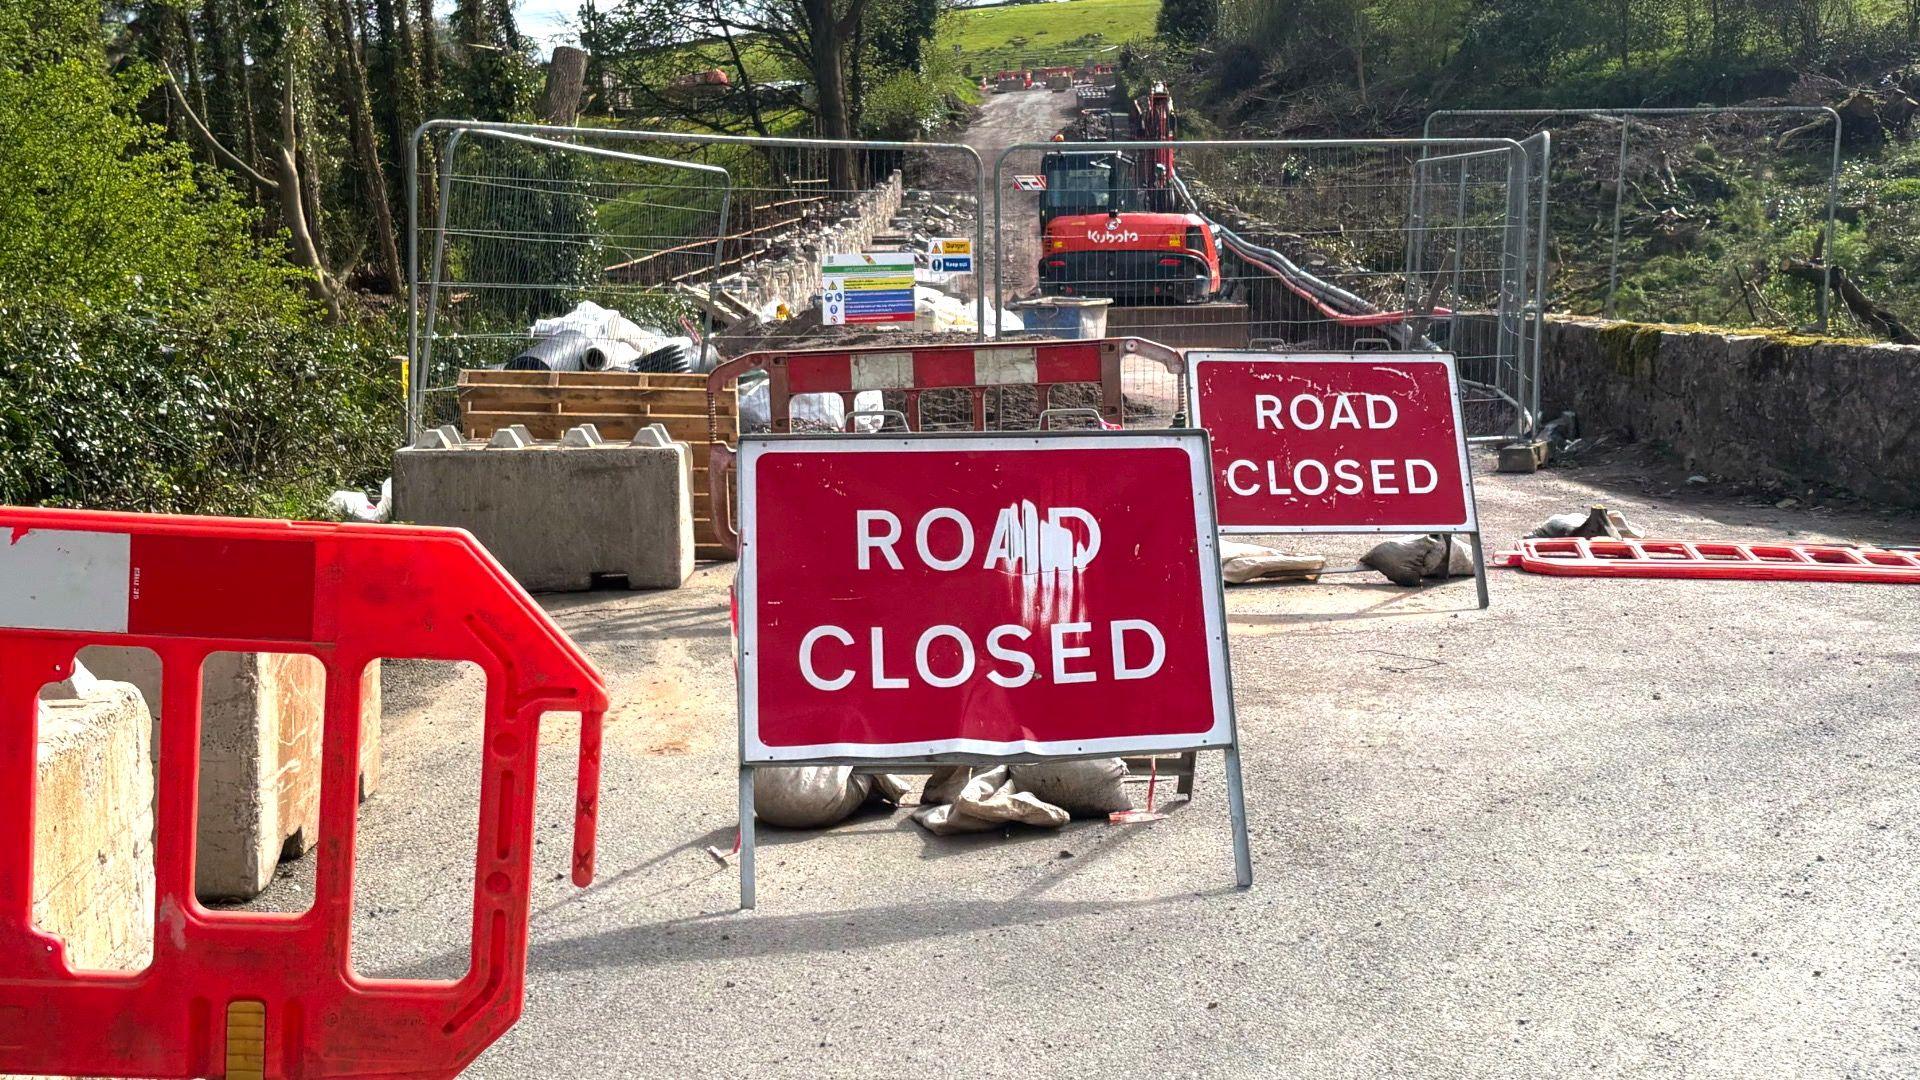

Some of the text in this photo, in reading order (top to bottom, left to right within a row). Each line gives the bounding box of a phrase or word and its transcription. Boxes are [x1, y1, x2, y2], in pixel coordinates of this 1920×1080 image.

[1087, 229, 1139, 244] Kubota
[1255, 393, 1399, 430] ROAD
[1227, 459, 1439, 496] CLOSED
[857, 506, 1102, 572] ROAD
[799, 618, 1166, 692] CLOSED
